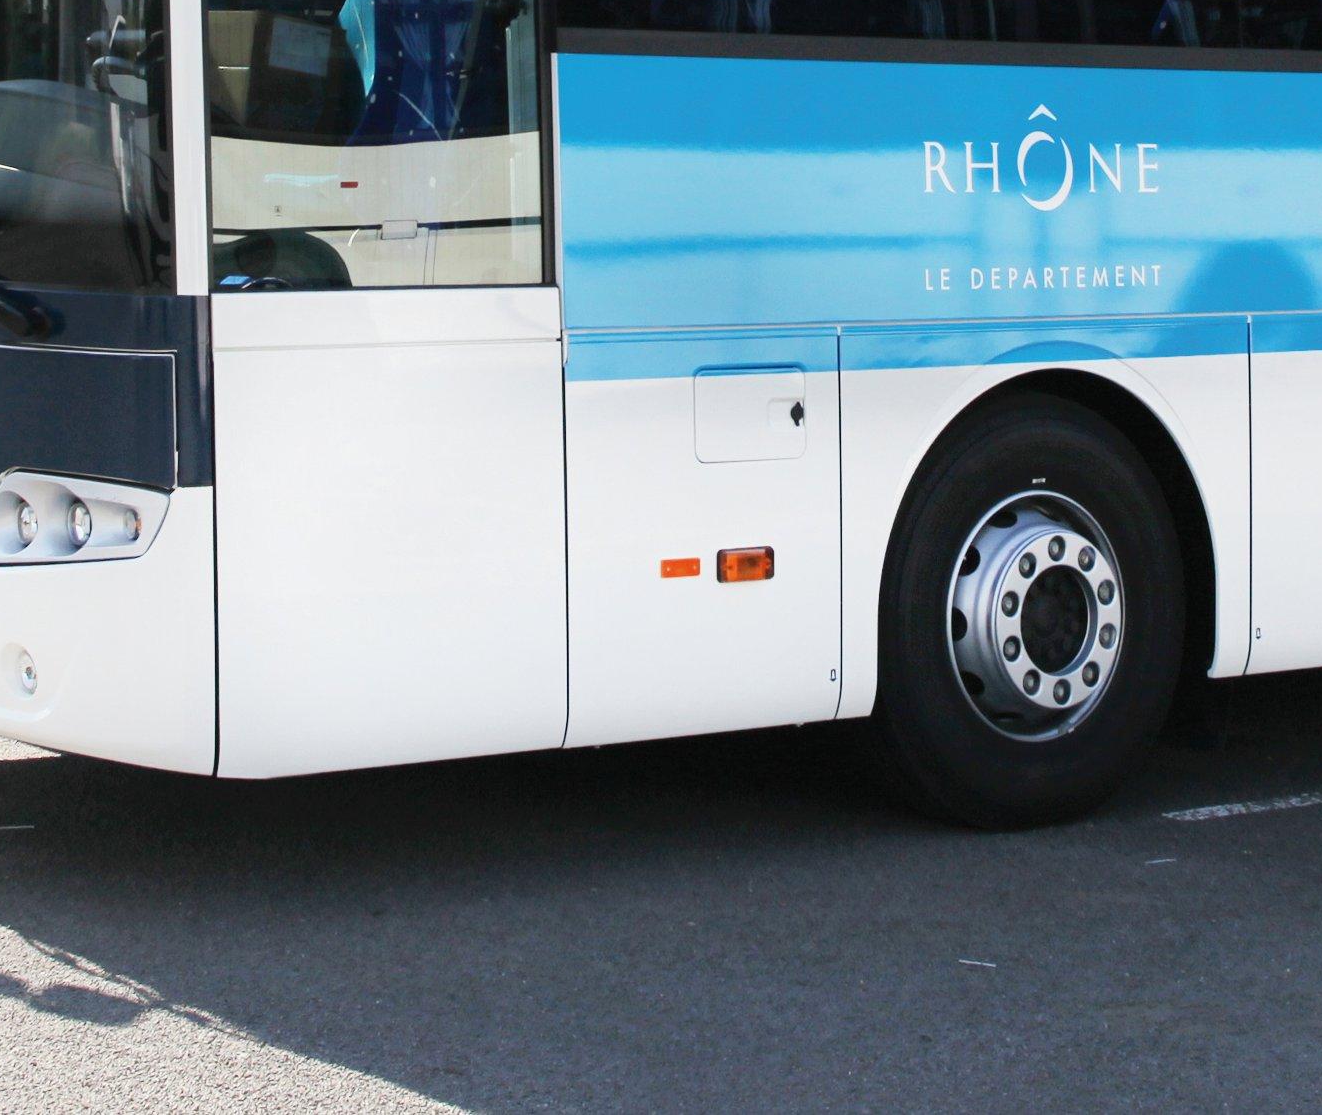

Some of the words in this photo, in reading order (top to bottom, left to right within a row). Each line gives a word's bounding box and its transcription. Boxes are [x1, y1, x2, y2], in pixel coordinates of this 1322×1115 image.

[922, 103, 1159, 211] RHÔNE
[924, 268, 951, 291] LE
[970, 265, 1161, 290] DEPARTEMENT
